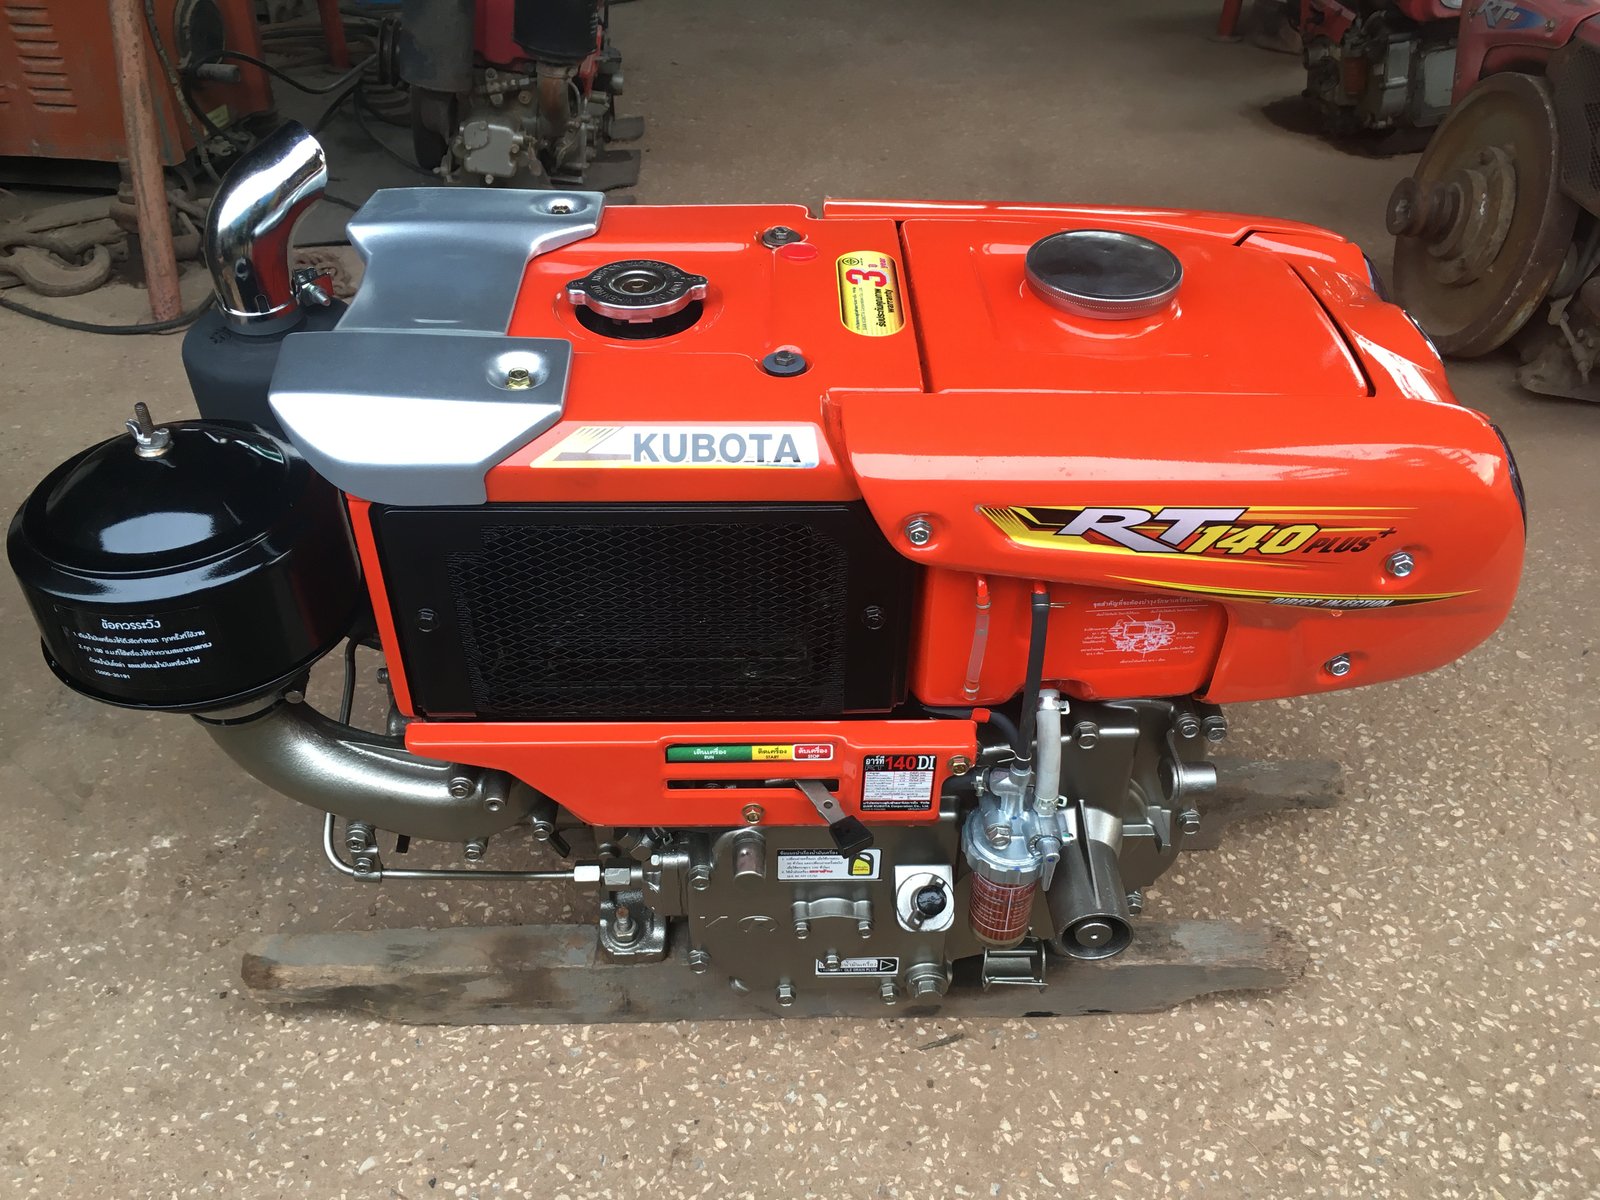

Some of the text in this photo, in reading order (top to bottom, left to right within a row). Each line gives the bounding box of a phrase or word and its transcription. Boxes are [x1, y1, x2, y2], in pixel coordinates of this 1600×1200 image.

[845, 268, 887, 288] 3
[884, 288, 895, 313] warranty
[633, 433, 801, 463] KUBOTA
[1273, 598, 1323, 606] DIRECT
[101, 618, 161, 630] ข้อควรระวัง
[865, 755, 885, 765] อาร์ที
